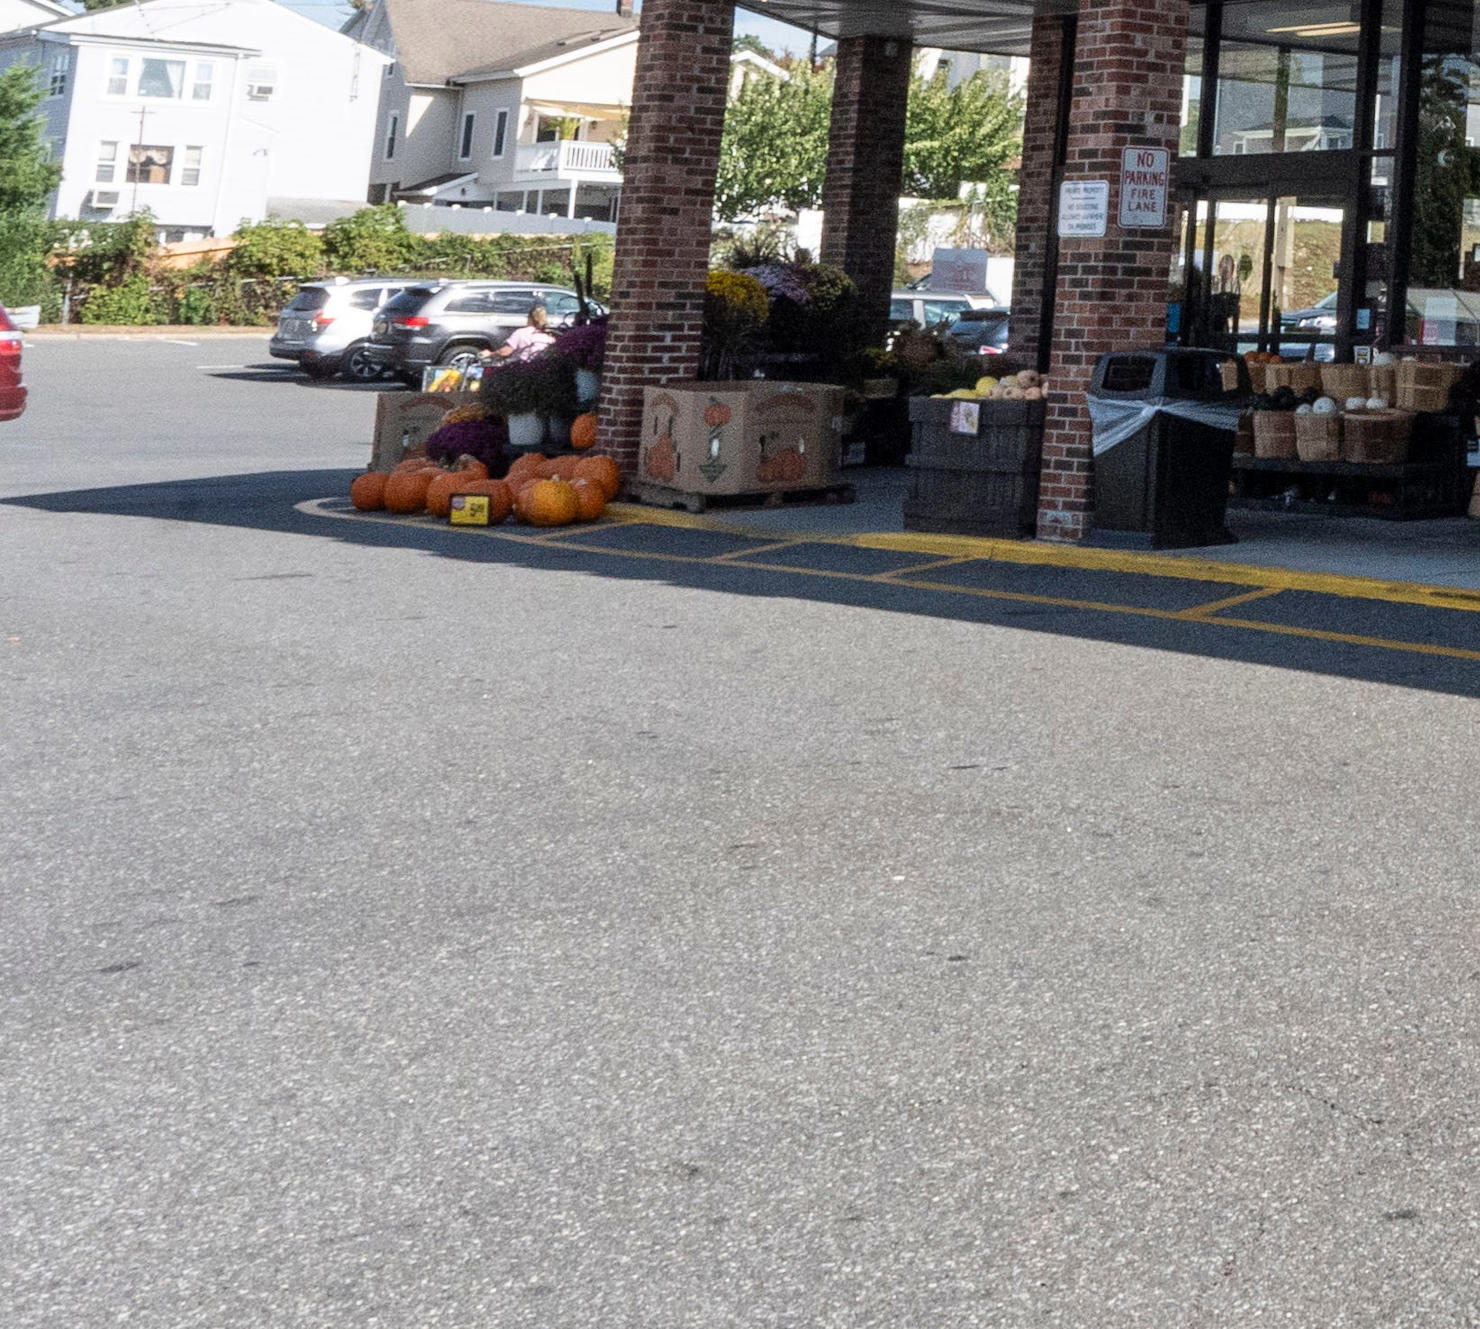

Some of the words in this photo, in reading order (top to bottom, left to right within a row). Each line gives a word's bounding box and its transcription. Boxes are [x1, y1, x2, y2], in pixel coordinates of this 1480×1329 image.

[1137, 152, 1154, 168] NO
[1124, 170, 1165, 186] PARKING
[1130, 188, 1156, 200] FIRE
[1128, 202, 1157, 213] LANE
